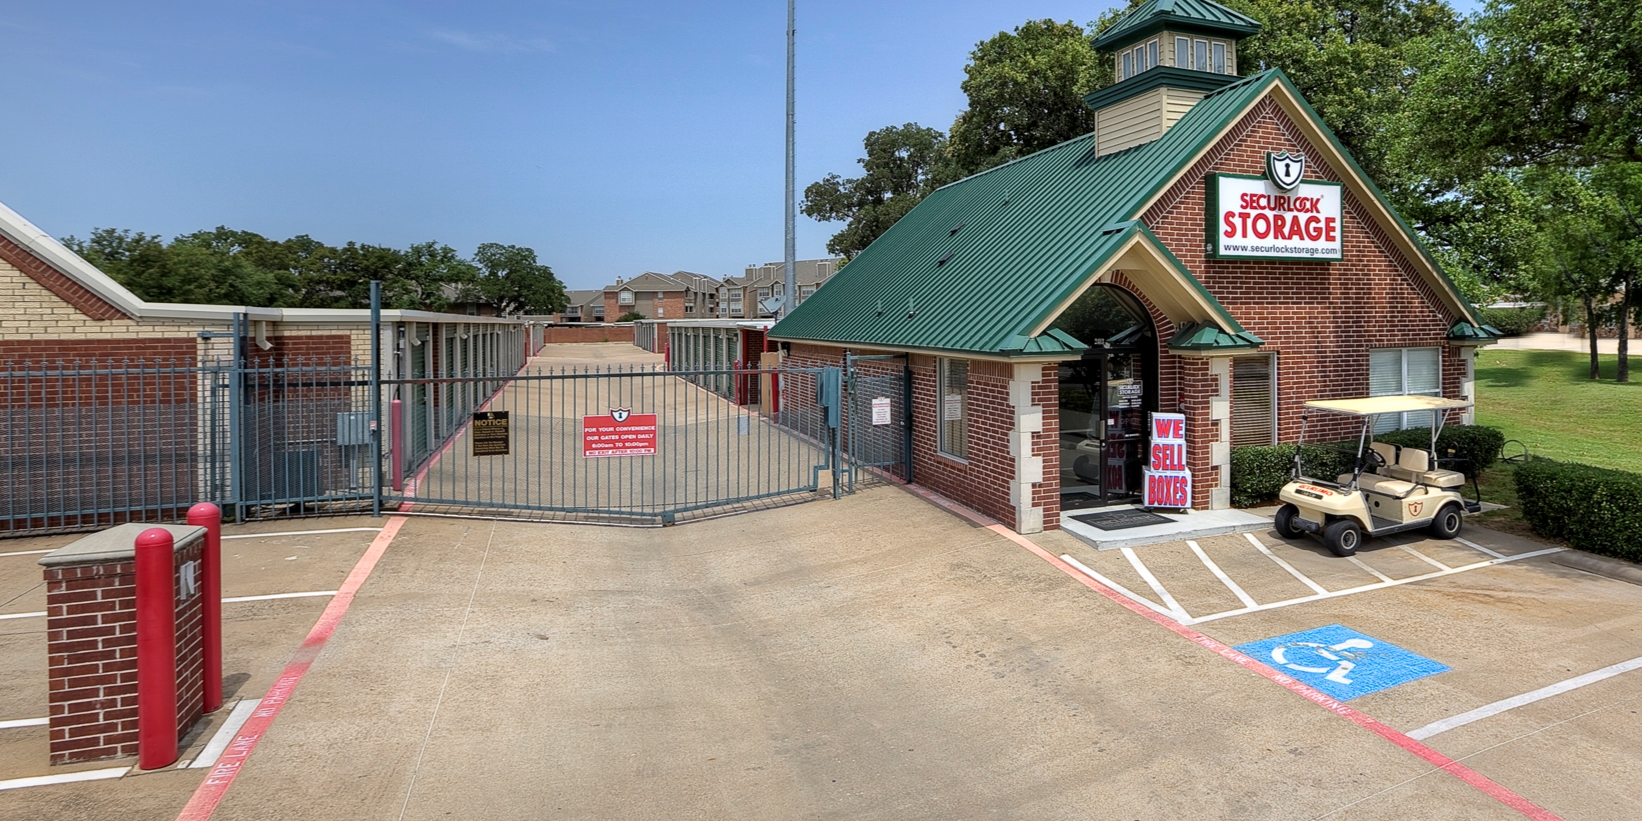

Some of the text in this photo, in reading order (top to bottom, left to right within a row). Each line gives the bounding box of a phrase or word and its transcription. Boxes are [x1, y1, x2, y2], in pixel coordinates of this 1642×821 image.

[1240, 192, 1321, 214] SECURLOCK
[1224, 210, 1336, 242] STORAGE
[1224, 244, 1338, 256] www.securlockstorage.com
[1154, 418, 1184, 439] WE
[1152, 444, 1185, 471] SELL
[1148, 475, 1188, 506] BOXES
[1194, 636, 1351, 714] FIRE LANE NO PARKING
[206, 762, 240, 784] FIRE
[224, 734, 259, 757] LANE
[254, 707, 276, 718] NO
